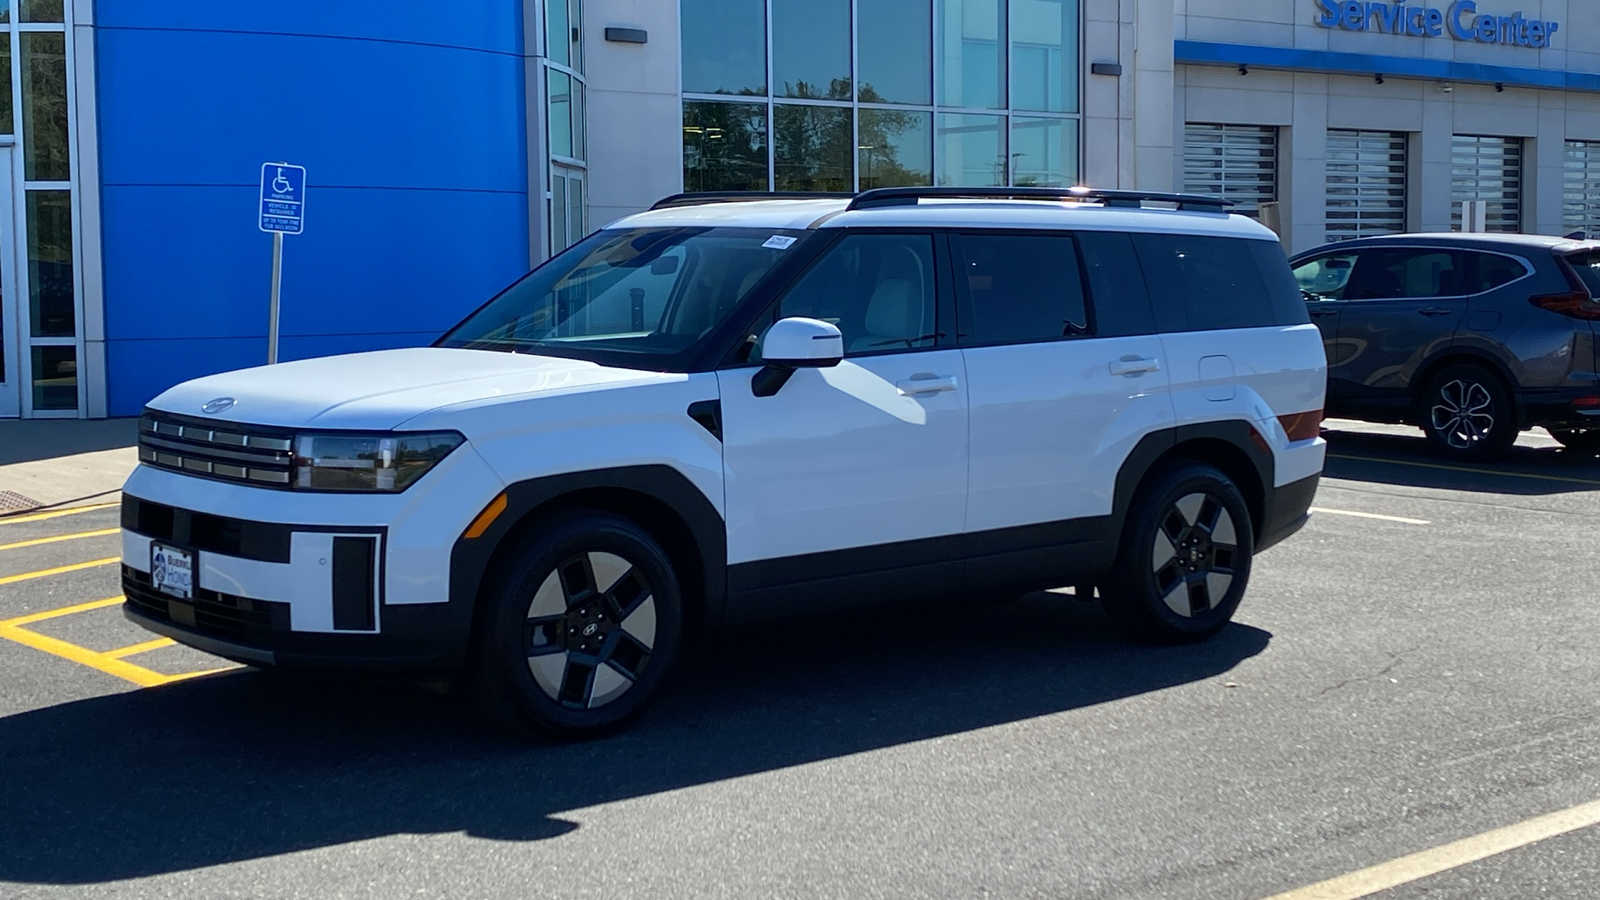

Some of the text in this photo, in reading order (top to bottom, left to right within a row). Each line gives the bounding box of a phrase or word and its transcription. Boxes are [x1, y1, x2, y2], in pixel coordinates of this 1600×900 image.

[1314, 0, 1559, 48] Service Center
[168, 555, 191, 570] BUERKL
